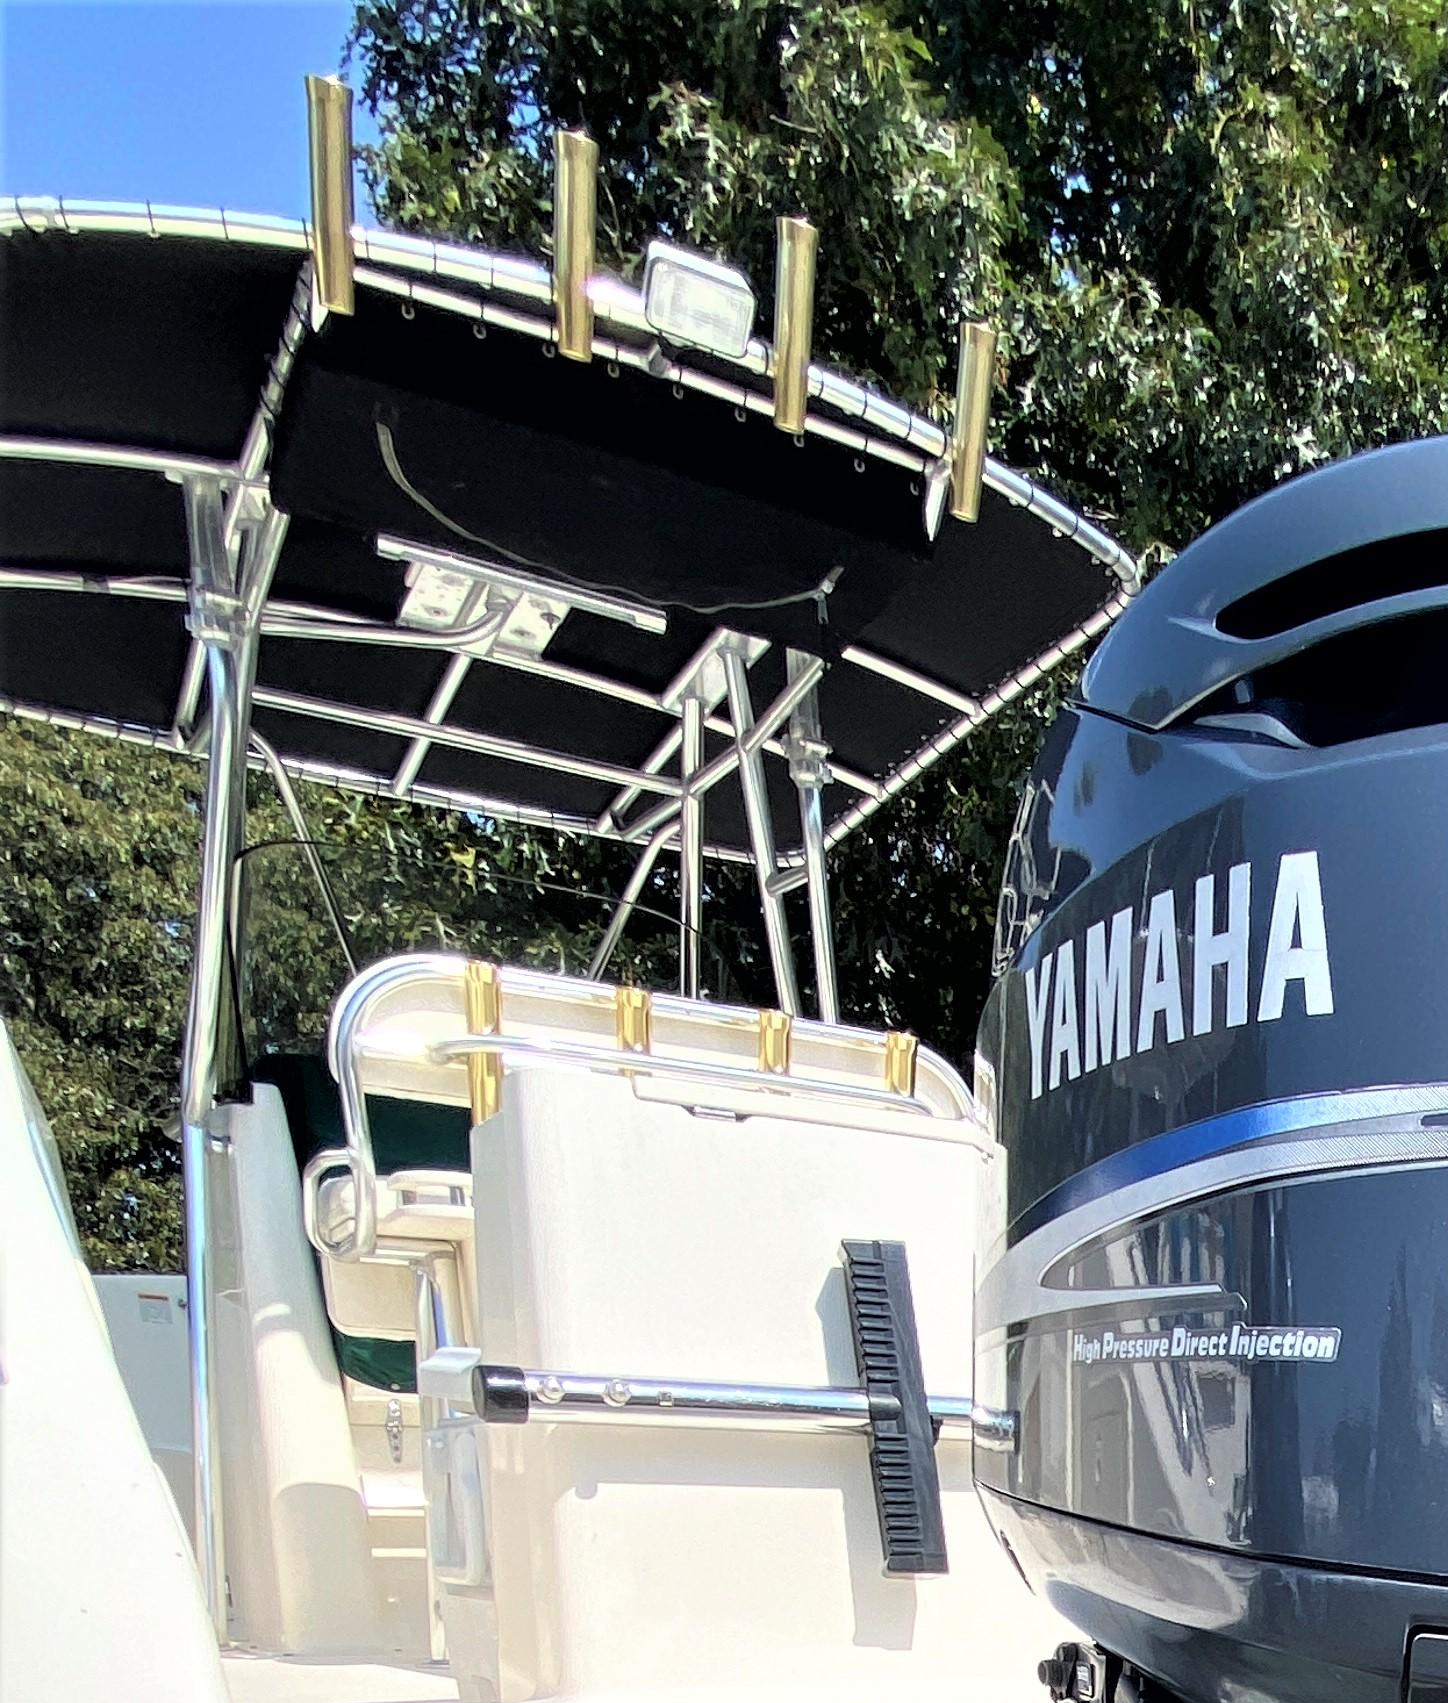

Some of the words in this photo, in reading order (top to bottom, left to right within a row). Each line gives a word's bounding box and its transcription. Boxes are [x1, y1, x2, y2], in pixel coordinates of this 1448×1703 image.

[1025, 850, 1335, 1100] YAMAHA
[1073, 1334, 1101, 1363] High
[1102, 1331, 1169, 1360] Pressure
[1170, 1327, 1229, 1357] Direct
[1229, 1324, 1337, 1360] Injection
